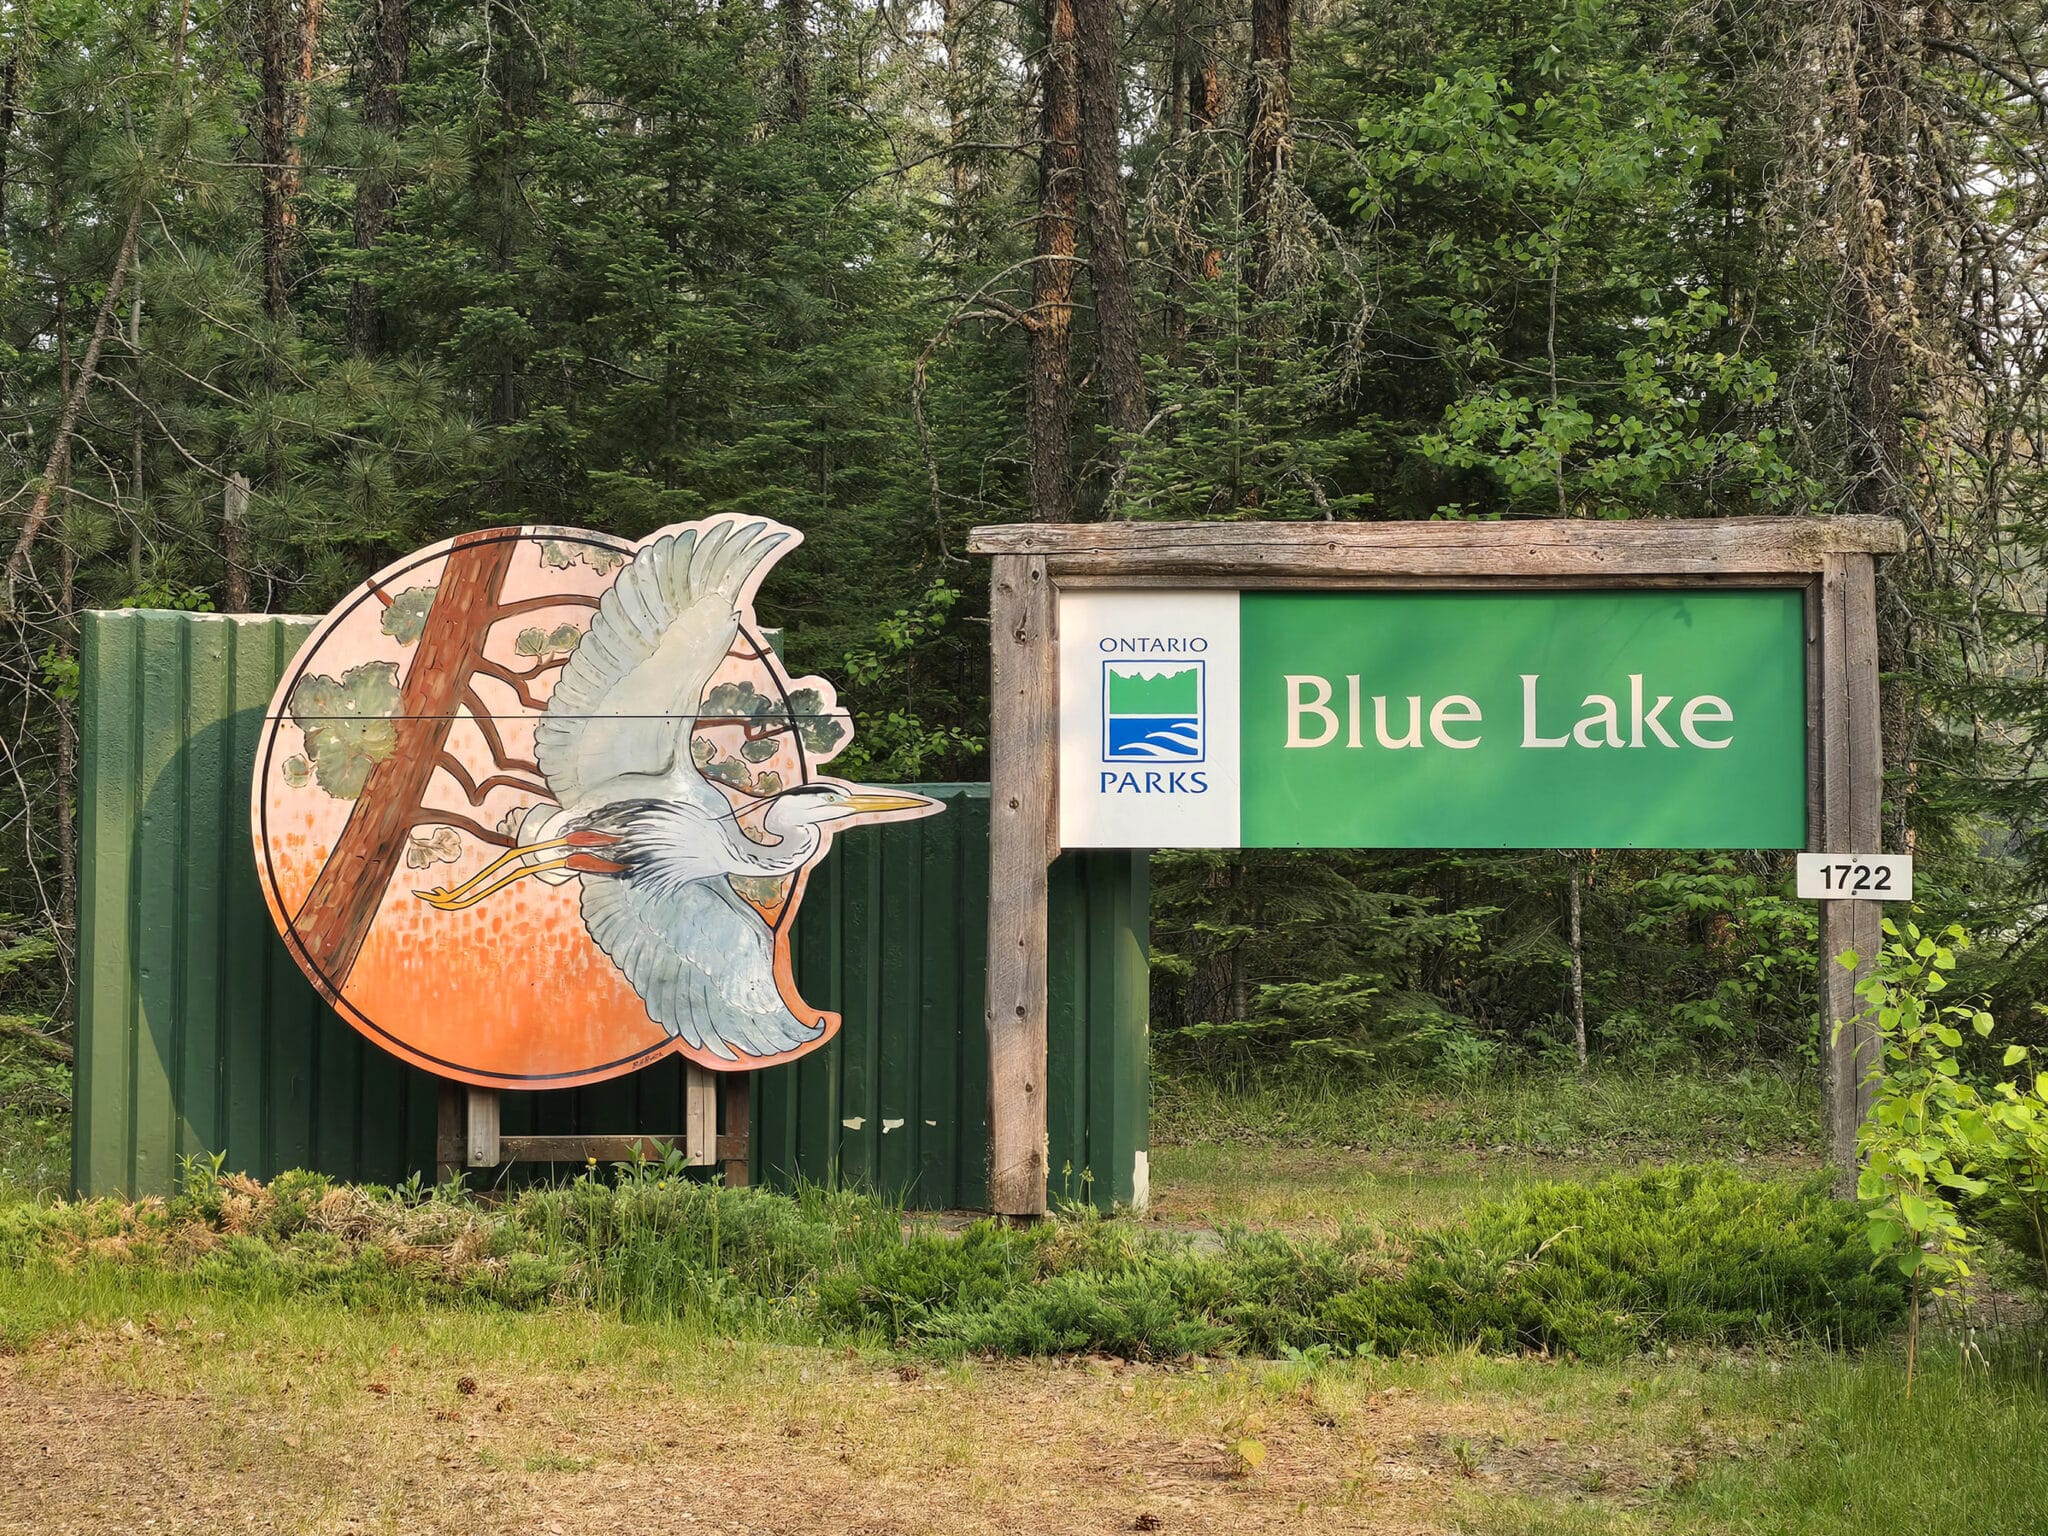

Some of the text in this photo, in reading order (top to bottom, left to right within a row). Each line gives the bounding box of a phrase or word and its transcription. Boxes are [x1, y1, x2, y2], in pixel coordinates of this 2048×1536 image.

[1099, 637, 1208, 653] ONTARIO
[1284, 673, 1734, 749] Blue Lake
[1101, 771, 1208, 794] PARKS
[1820, 865, 1891, 890] 1722
